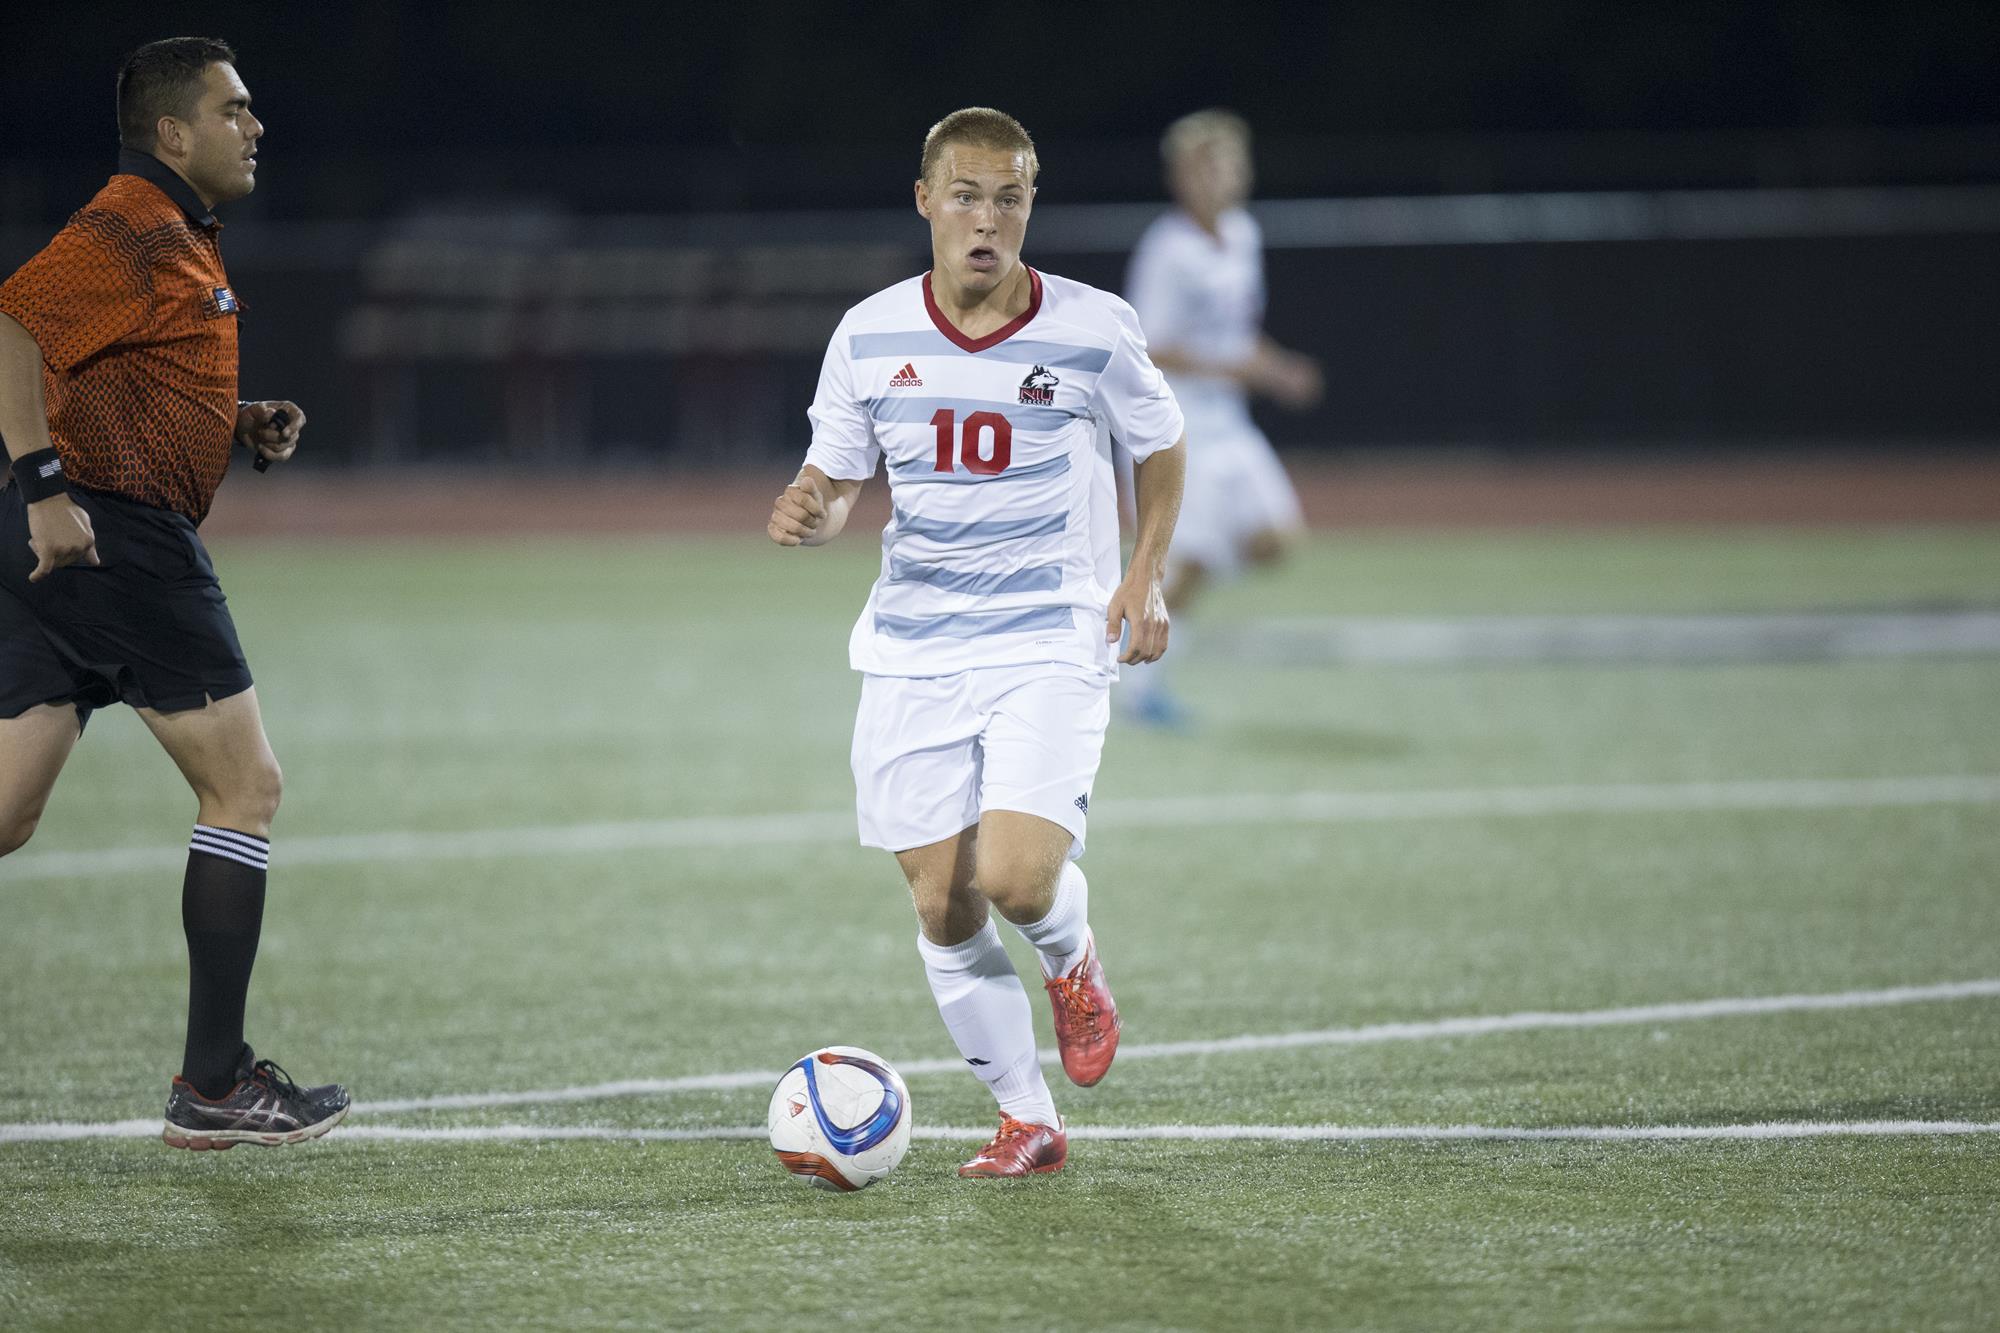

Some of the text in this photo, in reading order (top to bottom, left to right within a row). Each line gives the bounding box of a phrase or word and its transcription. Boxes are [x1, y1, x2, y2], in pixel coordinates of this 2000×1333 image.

[889, 378, 923, 387] adidas
[1019, 386, 1054, 401] NIU
[929, 408, 1013, 475] 10
